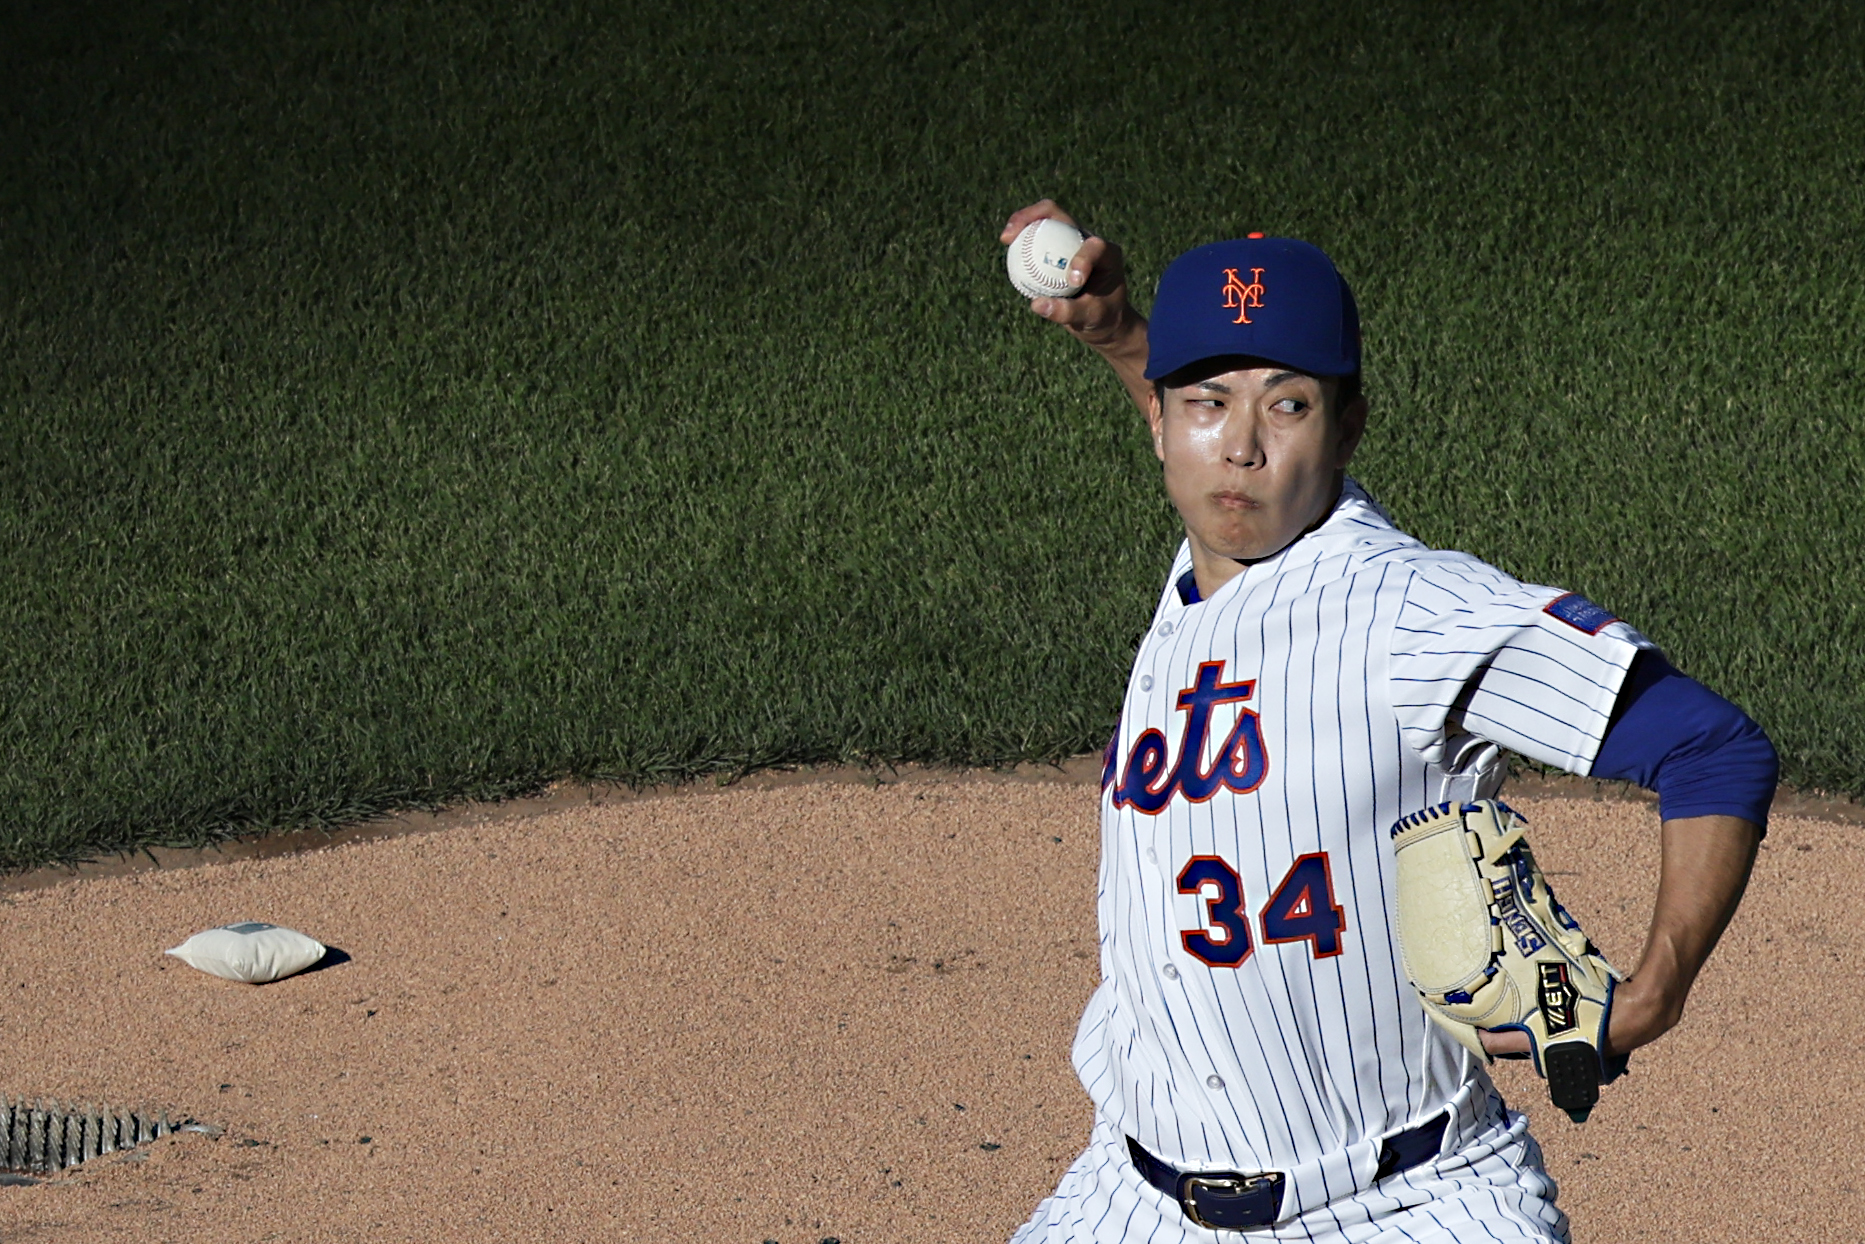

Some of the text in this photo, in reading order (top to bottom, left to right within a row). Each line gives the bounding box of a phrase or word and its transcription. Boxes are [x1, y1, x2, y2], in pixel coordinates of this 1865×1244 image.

[1222, 267, 1265, 324] NY
[1101, 660, 1270, 815] ets
[1176, 851, 1347, 968] 34
[1541, 964, 1566, 1028] ZETT
